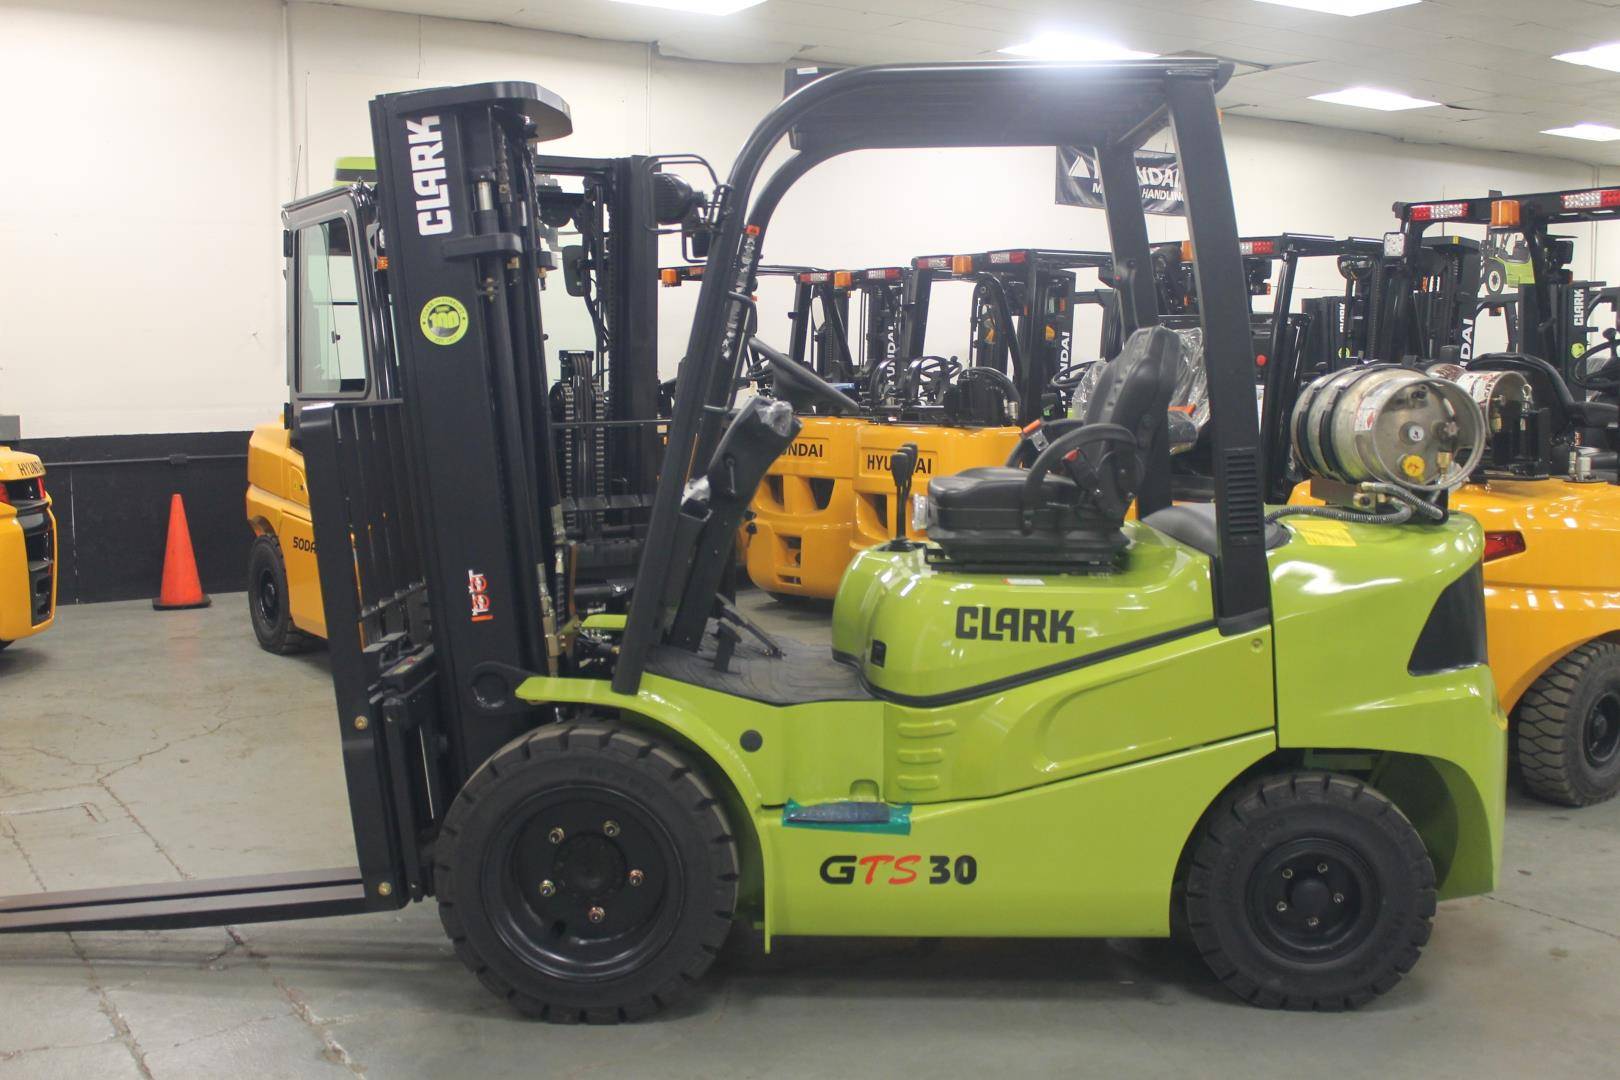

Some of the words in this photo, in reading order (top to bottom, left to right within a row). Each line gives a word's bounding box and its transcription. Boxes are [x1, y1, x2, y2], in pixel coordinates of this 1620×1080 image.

[406, 115, 453, 236] CLARK
[1141, 188, 1184, 202] HANDLIN
[1573, 288, 1585, 327] CLARK
[867, 454, 932, 474] HYUAI
[955, 606, 1076, 644] CLARK
